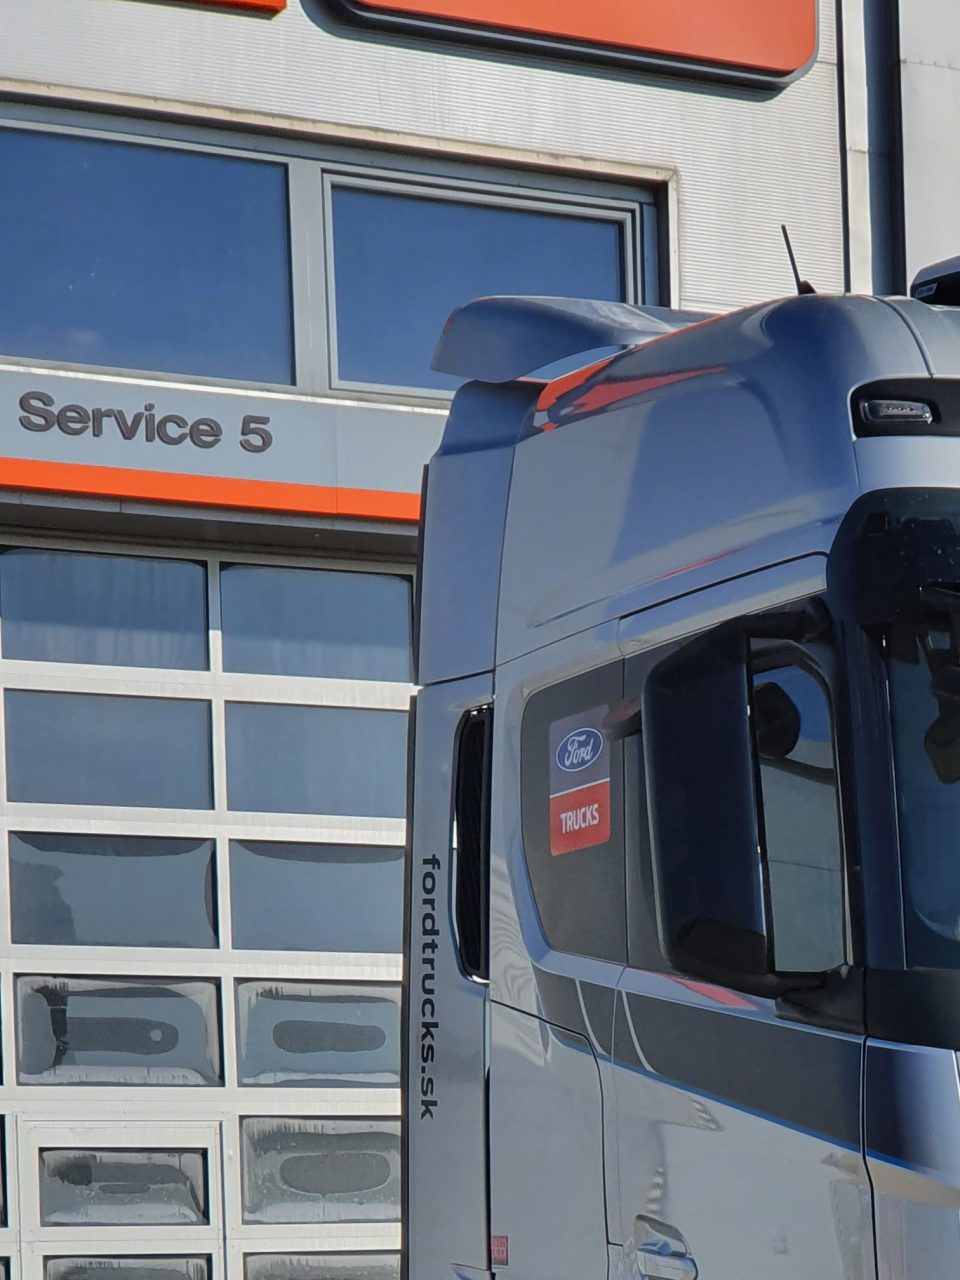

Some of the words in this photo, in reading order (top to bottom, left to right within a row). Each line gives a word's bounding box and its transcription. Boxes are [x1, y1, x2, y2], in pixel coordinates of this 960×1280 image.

[18, 390, 223, 449] Service
[239, 414, 273, 453] 5
[560, 803, 599, 834] TRUCKS
[420, 853, 441, 1120] fordtrucks.sk
